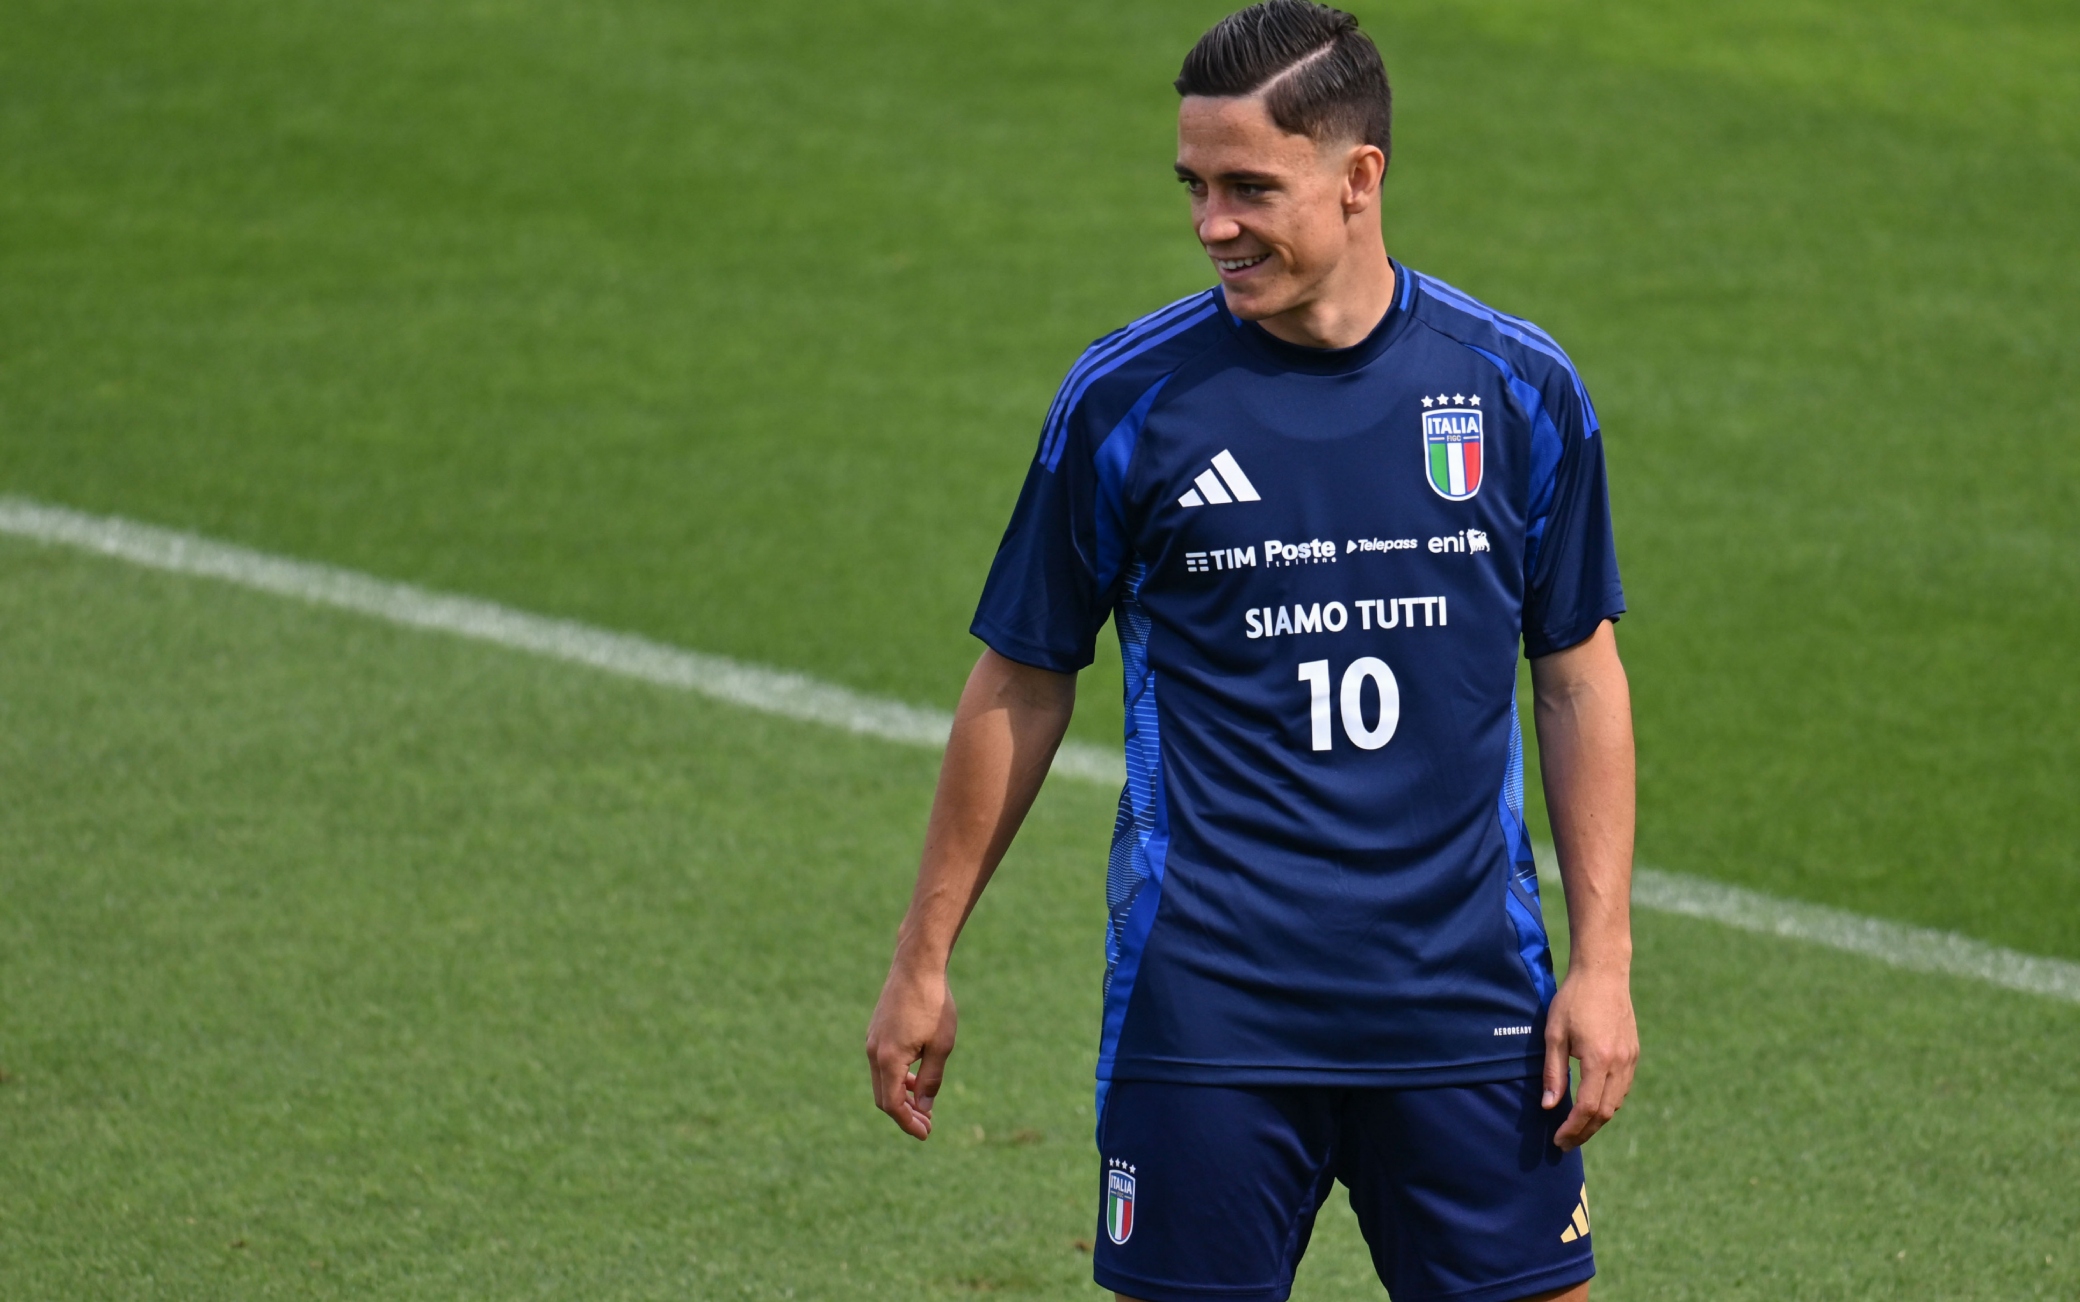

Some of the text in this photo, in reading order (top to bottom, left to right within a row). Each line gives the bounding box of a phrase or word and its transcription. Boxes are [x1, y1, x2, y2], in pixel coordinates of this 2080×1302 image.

[1427, 416, 1479, 435] ITALIA
[1446, 434, 1462, 442] FIGC
[1264, 538, 1336, 562] Poste
[1358, 537, 1418, 552] Telepass
[1427, 530, 1465, 554] eni
[1211, 546, 1257, 571] TIM
[1245, 596, 1447, 639] SIAMO TUTTI
[1298, 656, 1400, 751] 10
[1493, 1026, 1532, 1036] AEROREADY
[1110, 1174, 1133, 1195] ITALIA
